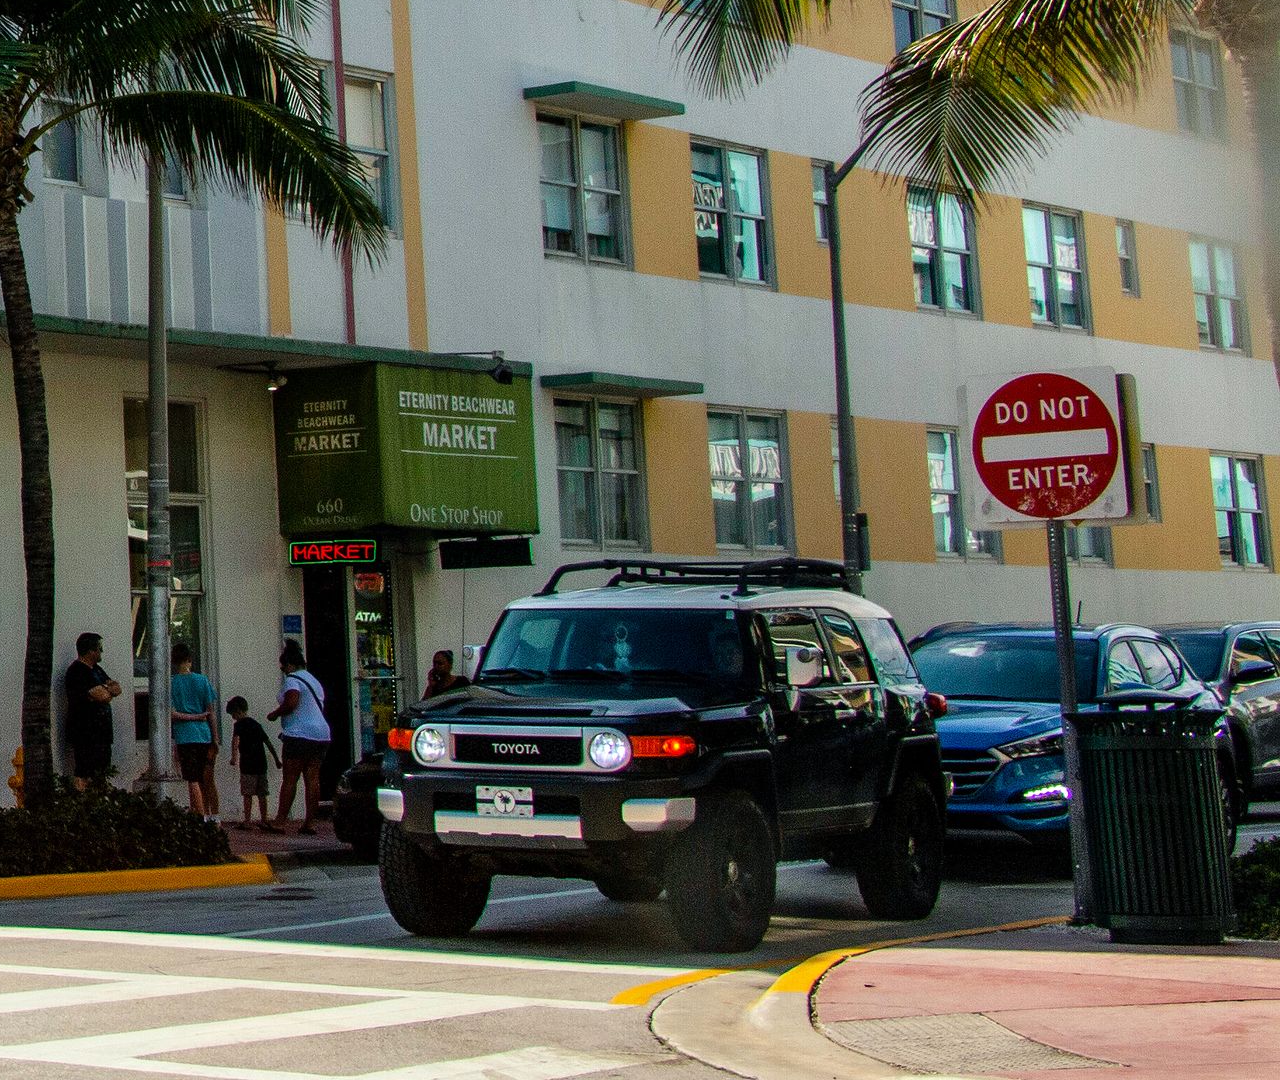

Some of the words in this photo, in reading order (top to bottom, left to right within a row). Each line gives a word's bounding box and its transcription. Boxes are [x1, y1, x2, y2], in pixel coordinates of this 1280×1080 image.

[303, 399, 348, 413] ETERNITY
[398, 391, 450, 411] ETERNITY
[451, 395, 516, 415] BEACHWEAR
[994, 401, 1028, 424] DO
[1040, 395, 1089, 420] NOT
[297, 414, 356, 429] BEACHWEAR
[293, 432, 361, 452] MARKET
[422, 422, 497, 451] MARKET
[1008, 464, 1090, 491] ENTER
[316, 497, 343, 514] 660
[293, 543, 374, 560] MARKET
[491, 743, 540, 755] TOYOTA
